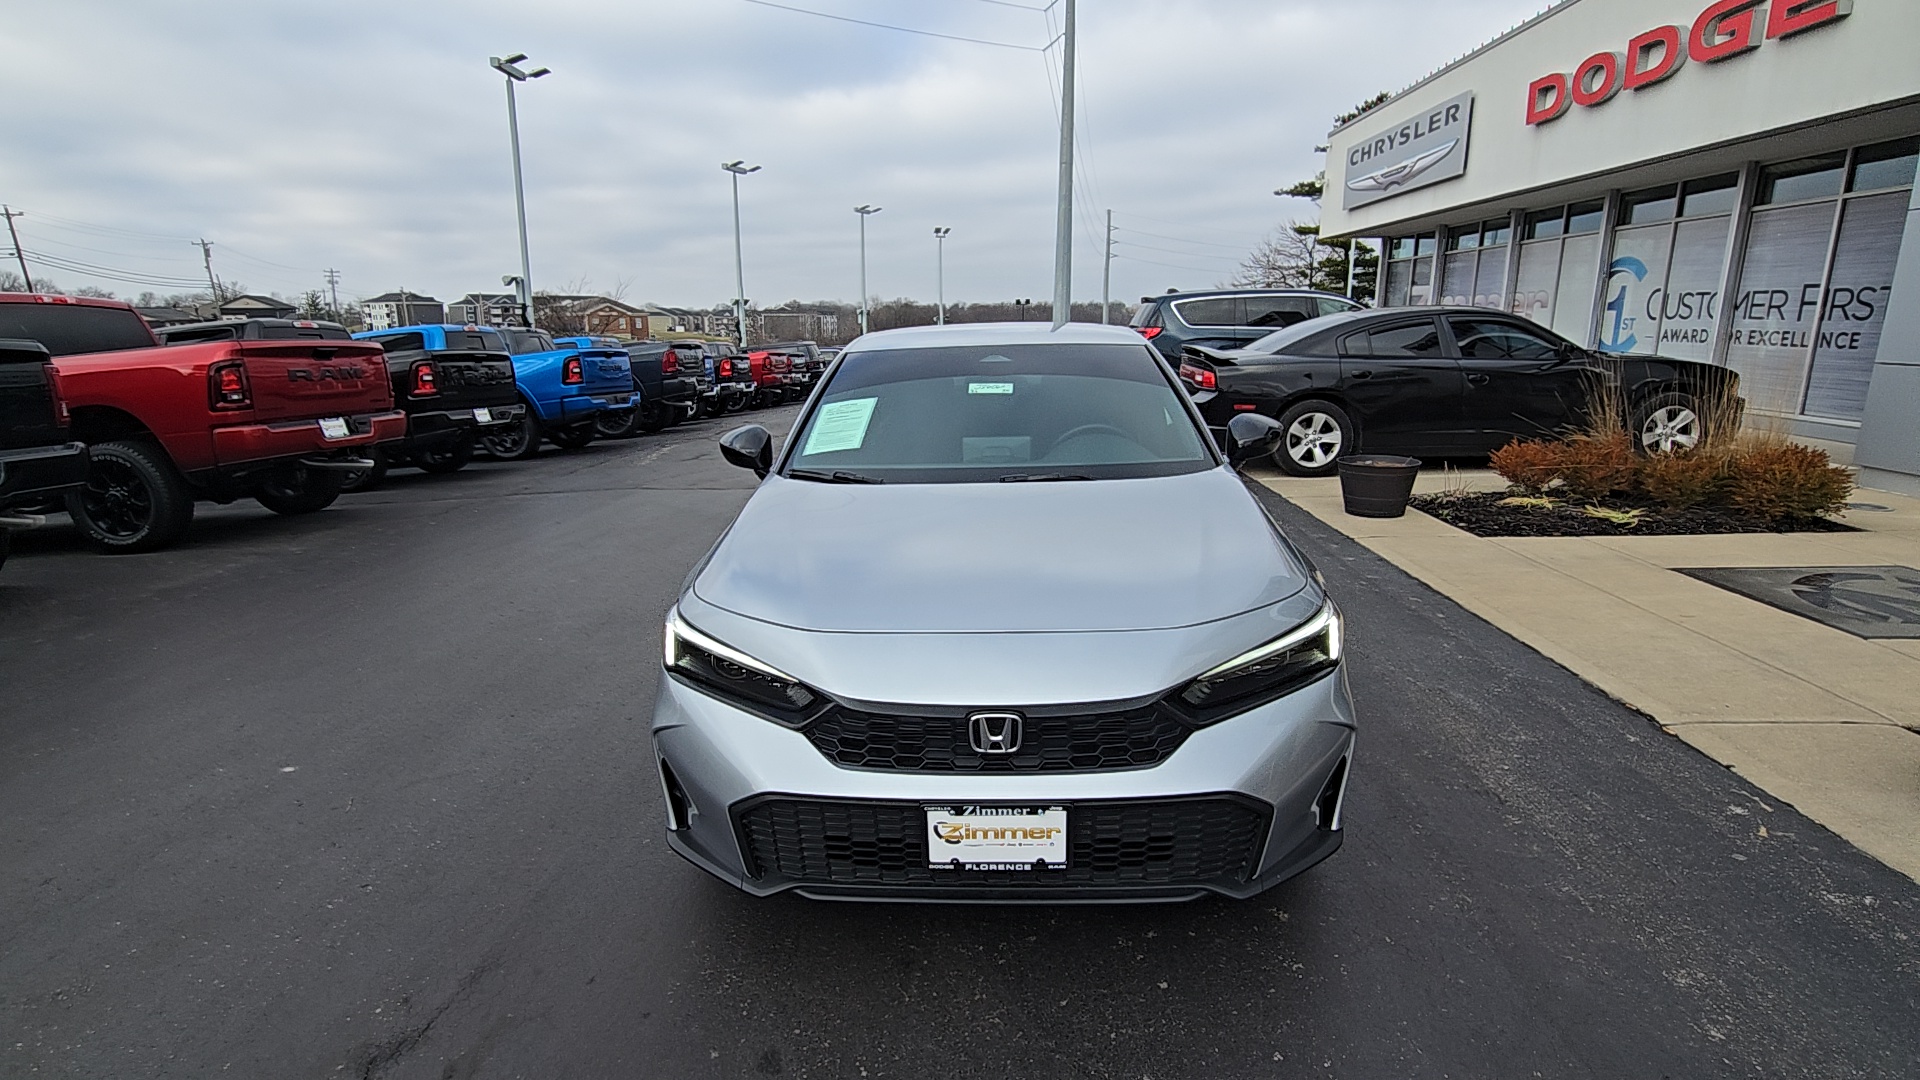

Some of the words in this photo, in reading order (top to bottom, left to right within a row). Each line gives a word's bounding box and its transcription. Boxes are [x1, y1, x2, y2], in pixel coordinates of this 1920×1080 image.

[1349, 103, 1461, 167] CHRYSLER
[1660, 328, 1709, 344] AWARD
[1746, 330, 1862, 350] EXCELLNCE
[287, 366, 363, 382] RAM
[962, 805, 1031, 817] Zimmer
[941, 823, 1061, 841] Zimmer
[965, 863, 1032, 871] FLORENCE
